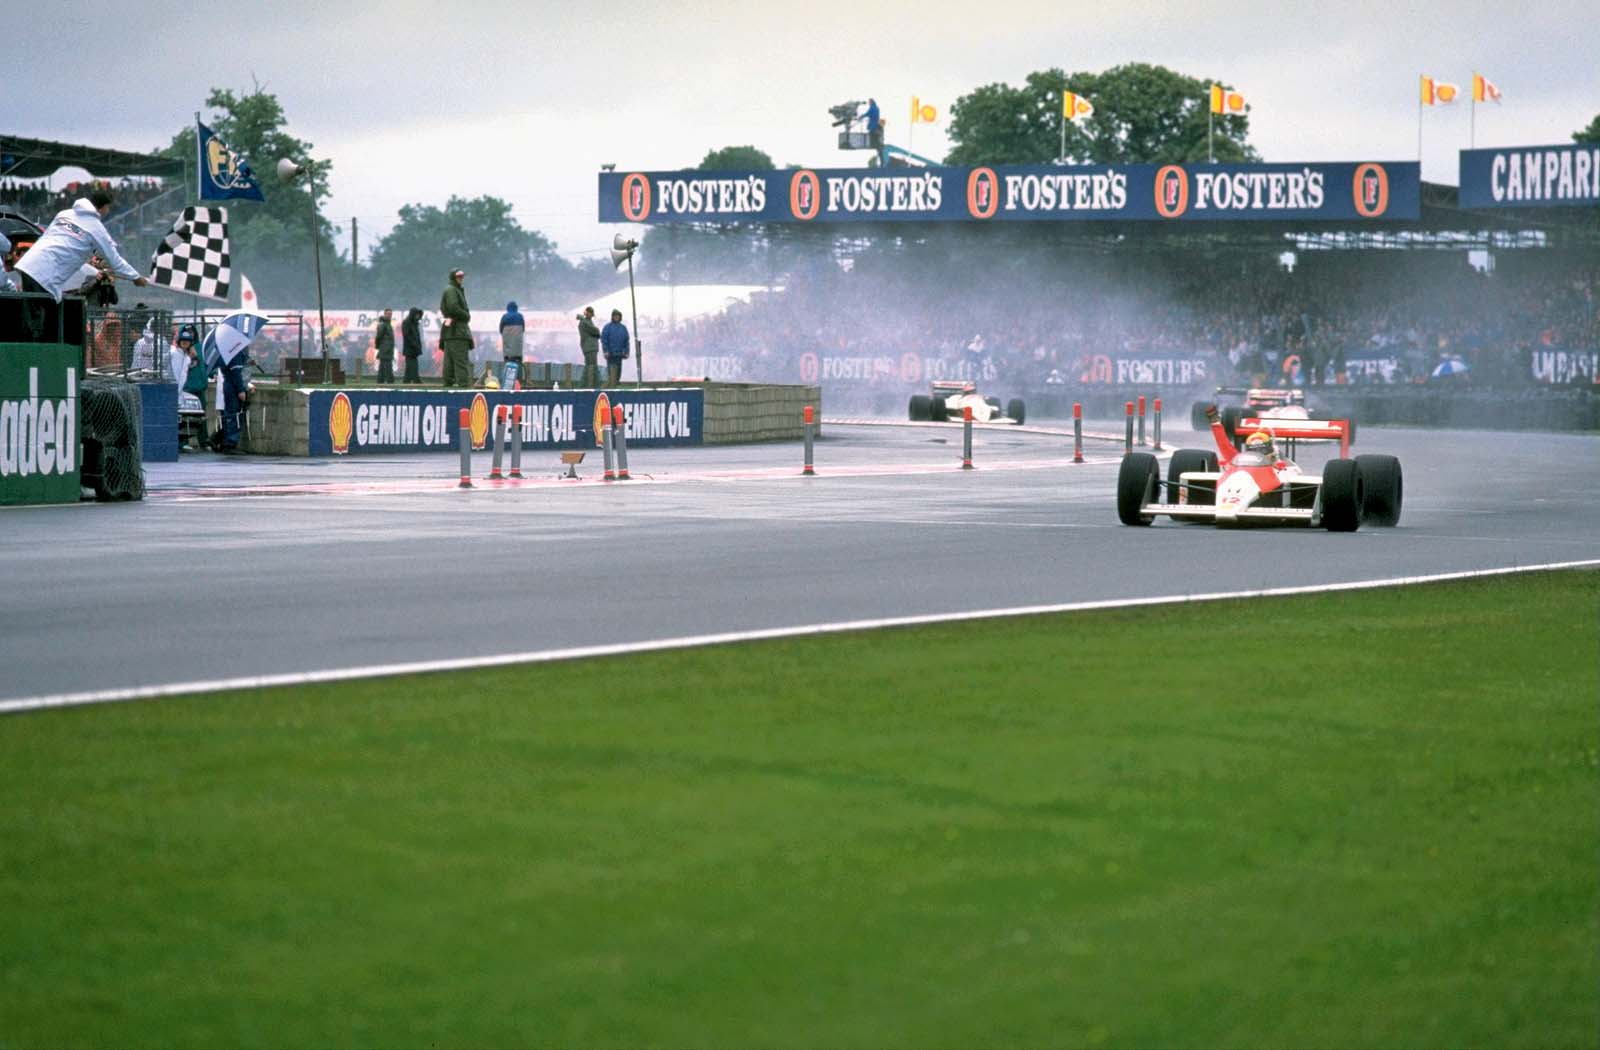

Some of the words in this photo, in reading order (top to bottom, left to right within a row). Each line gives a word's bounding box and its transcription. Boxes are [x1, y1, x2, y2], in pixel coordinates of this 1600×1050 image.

[657, 174, 766, 213] FOSTER'S
[827, 171, 942, 212] FOSTER'S
[1005, 169, 1127, 210] FOSTER'S
[1195, 167, 1324, 209] FOSTER'S
[1492, 149, 1600, 202] CAMPARI
[822, 356, 894, 379] FOSTE
[0, 367, 76, 477] aded
[356, 403, 420, 446] GEMINI
[422, 404, 450, 446] OIL
[551, 403, 576, 442] OIL
[614, 402, 665, 439] EMINI
[667, 401, 690, 438] OIL
